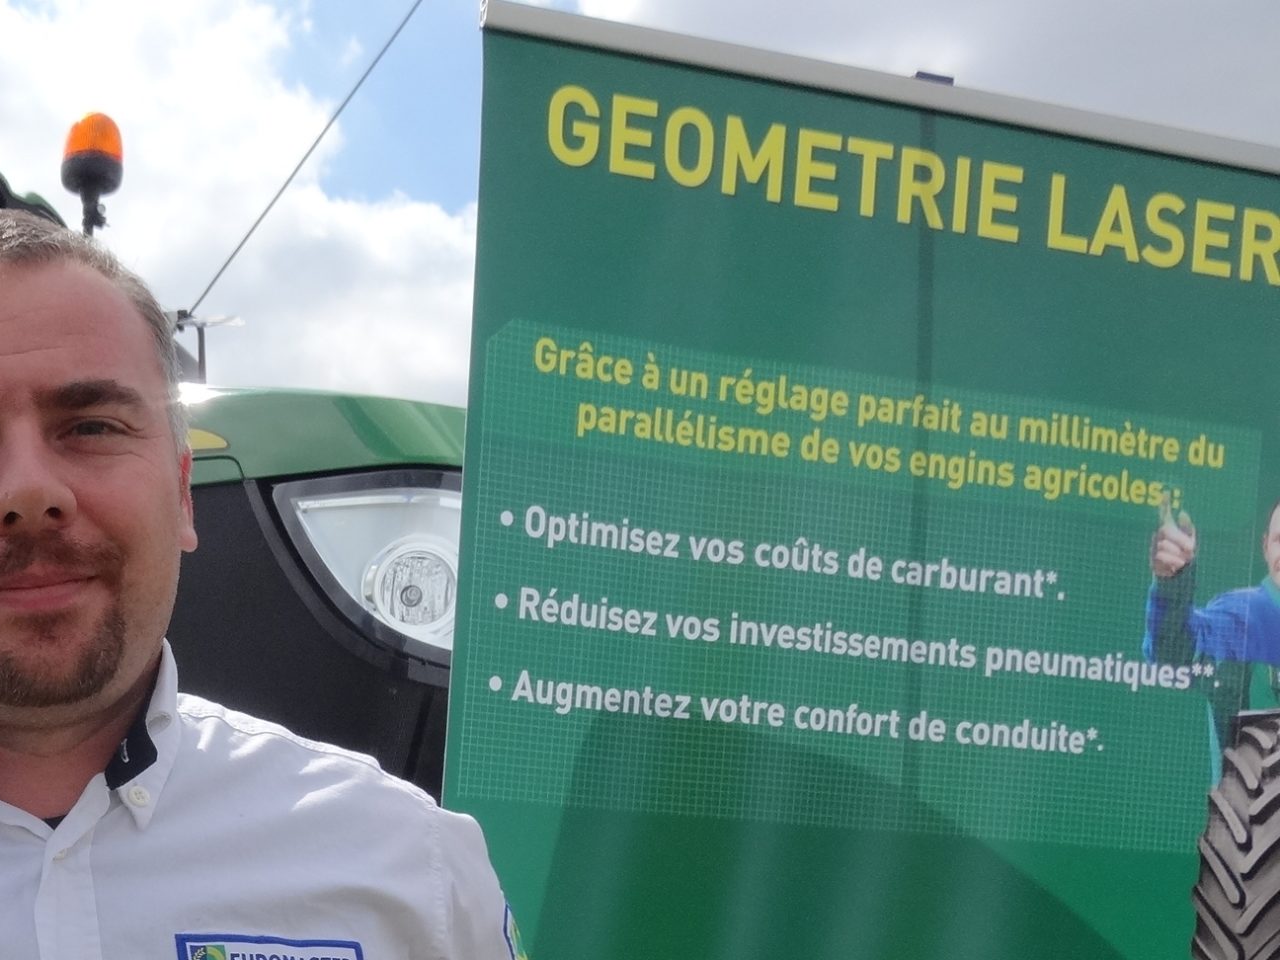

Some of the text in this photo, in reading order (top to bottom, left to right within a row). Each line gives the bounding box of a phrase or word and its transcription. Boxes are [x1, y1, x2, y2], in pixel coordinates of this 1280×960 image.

[548, 85, 1280, 286] GEOMETRIE LASER
[533, 336, 1225, 469] Grâce à un réglage parfait au millimètre du
[577, 402, 791, 458] parallélisme
[800, 427, 840, 464] de
[848, 440, 902, 473] vos
[909, 449, 1015, 490] engins
[524, 505, 680, 559] Optimisez
[688, 535, 745, 565] vos
[754, 537, 839, 575] coûts
[847, 547, 883, 581] de
[519, 586, 658, 637] Réduisez
[666, 612, 720, 642] vos
[729, 612, 976, 669] investissements
[511, 669, 691, 720] Augmentez
[700, 694, 785, 728] votre
[793, 703, 900, 739] confort
[908, 711, 946, 743] de
